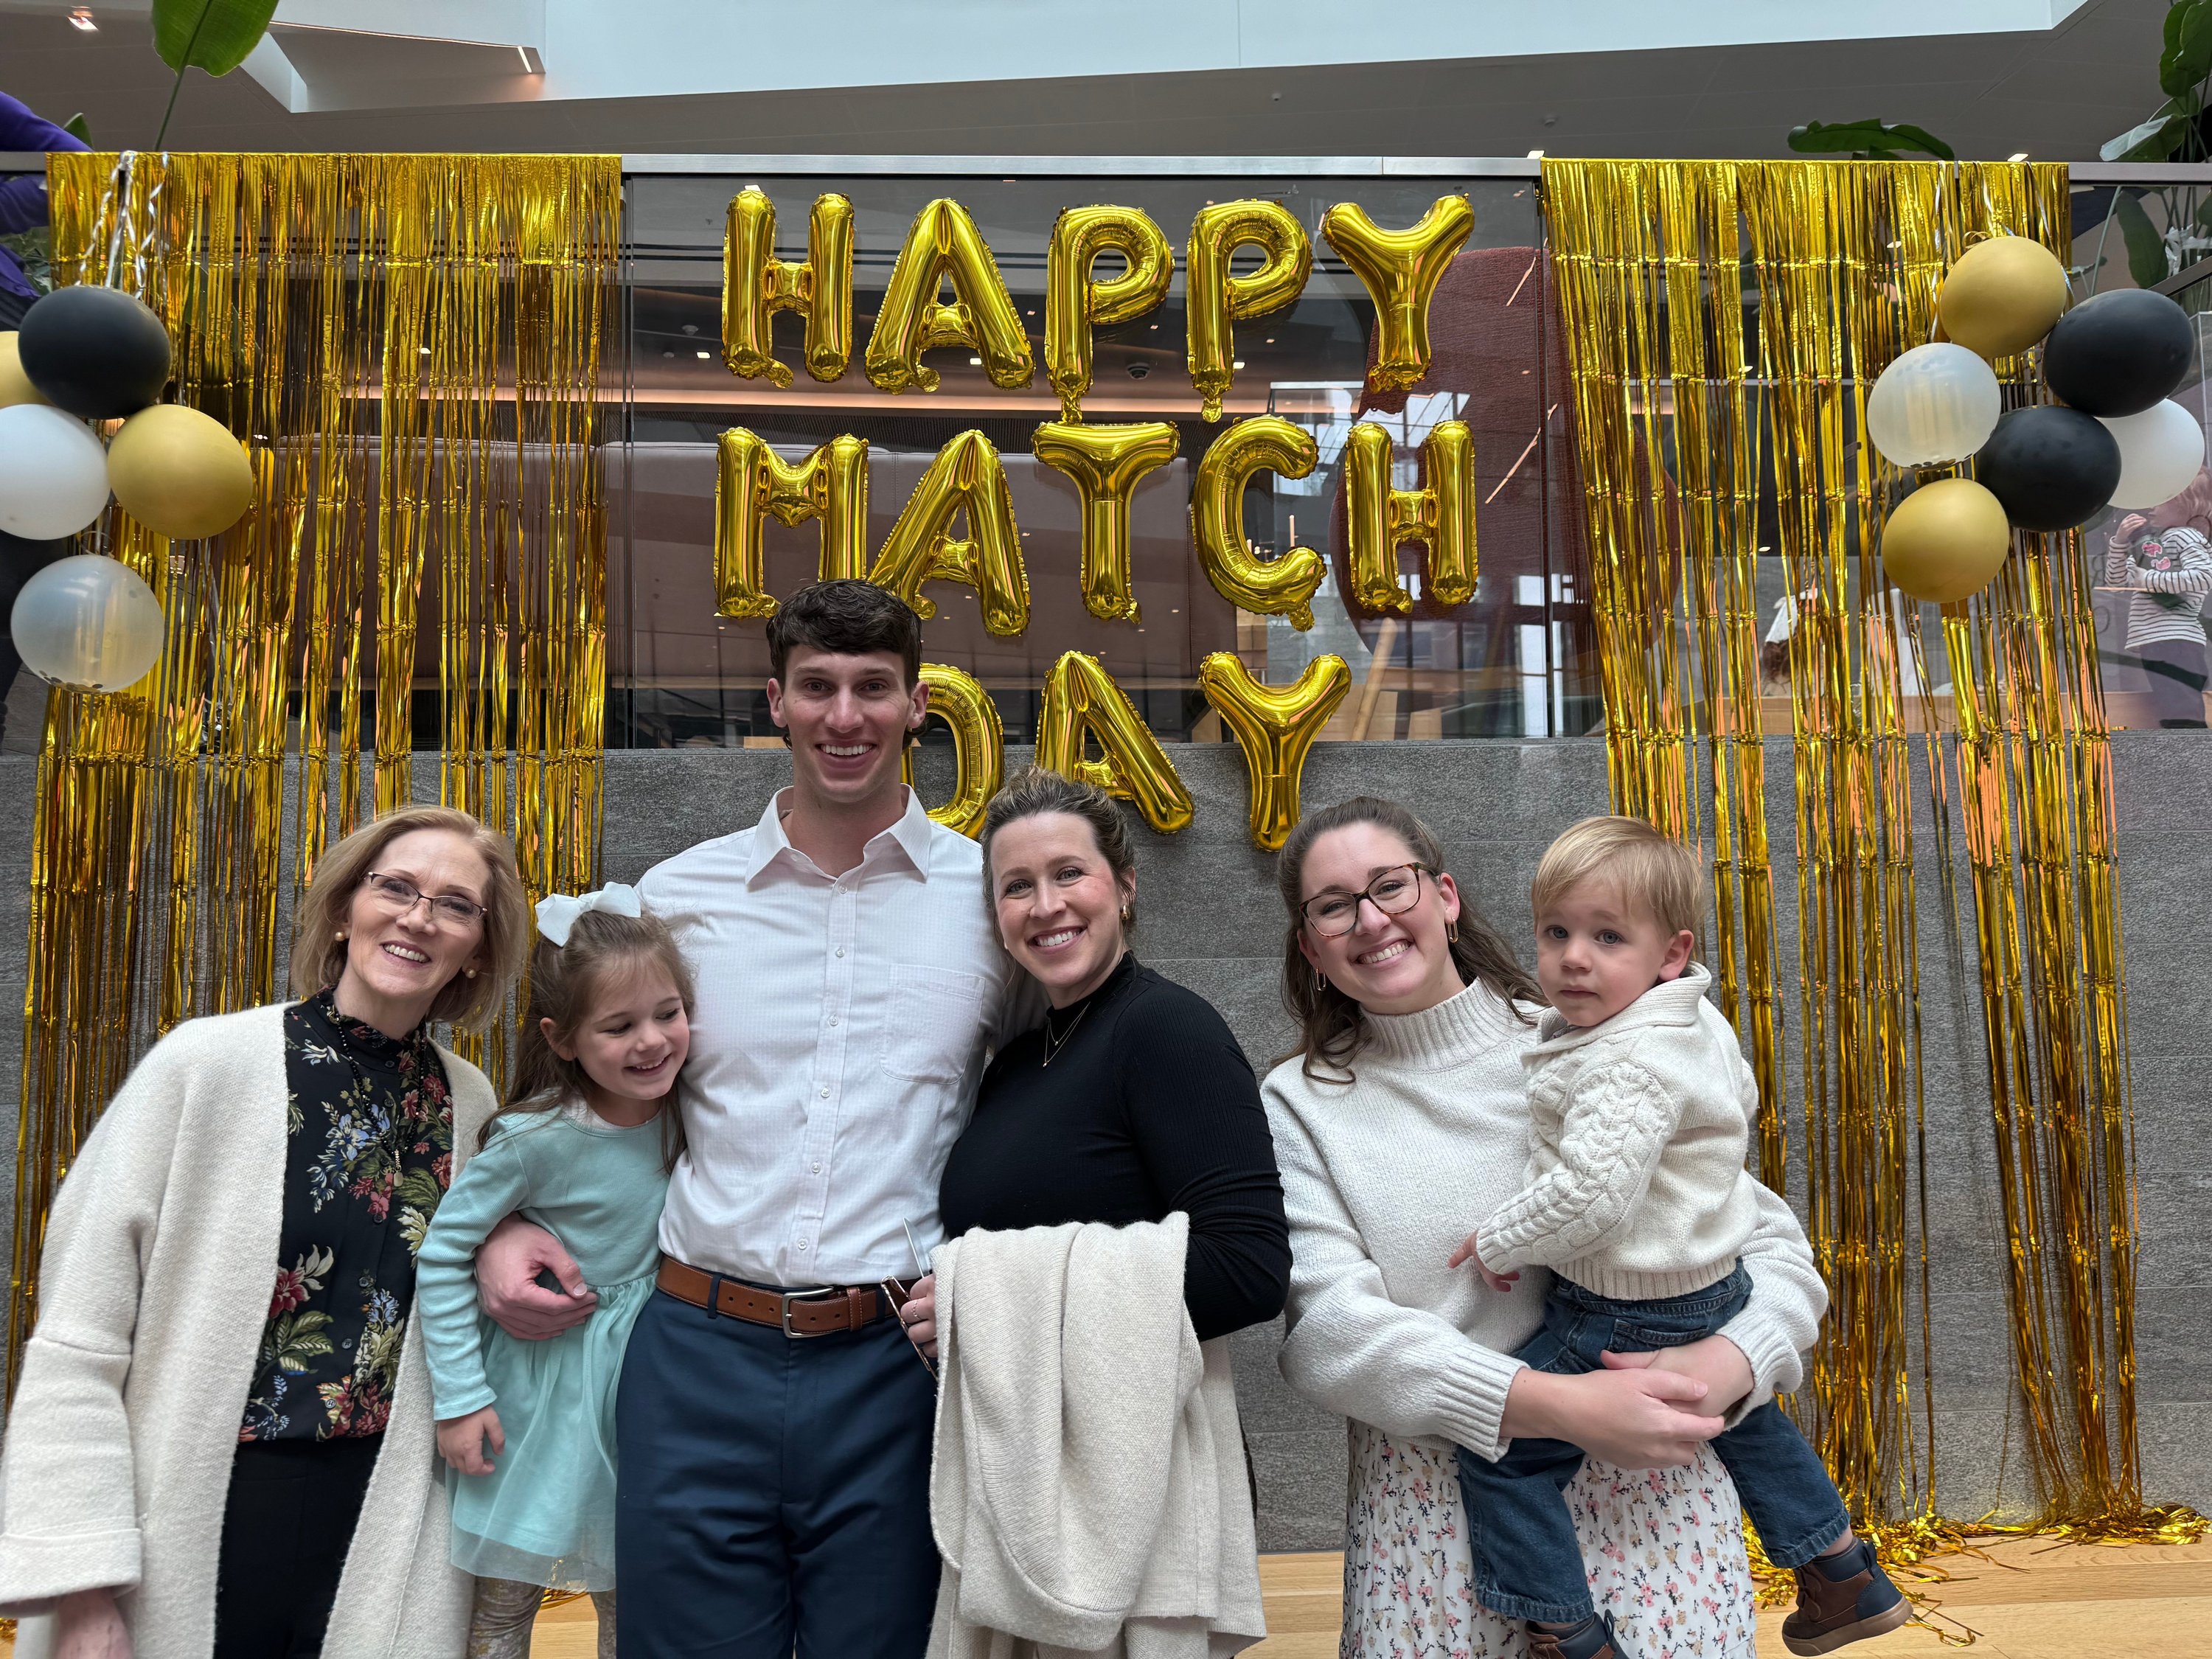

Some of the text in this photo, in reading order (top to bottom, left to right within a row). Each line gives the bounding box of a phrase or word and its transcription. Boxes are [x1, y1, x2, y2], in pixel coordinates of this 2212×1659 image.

[721, 187, 1475, 422] HAPPY
[714, 413, 1480, 637] MATCH
[900, 650, 1353, 852] DAY
